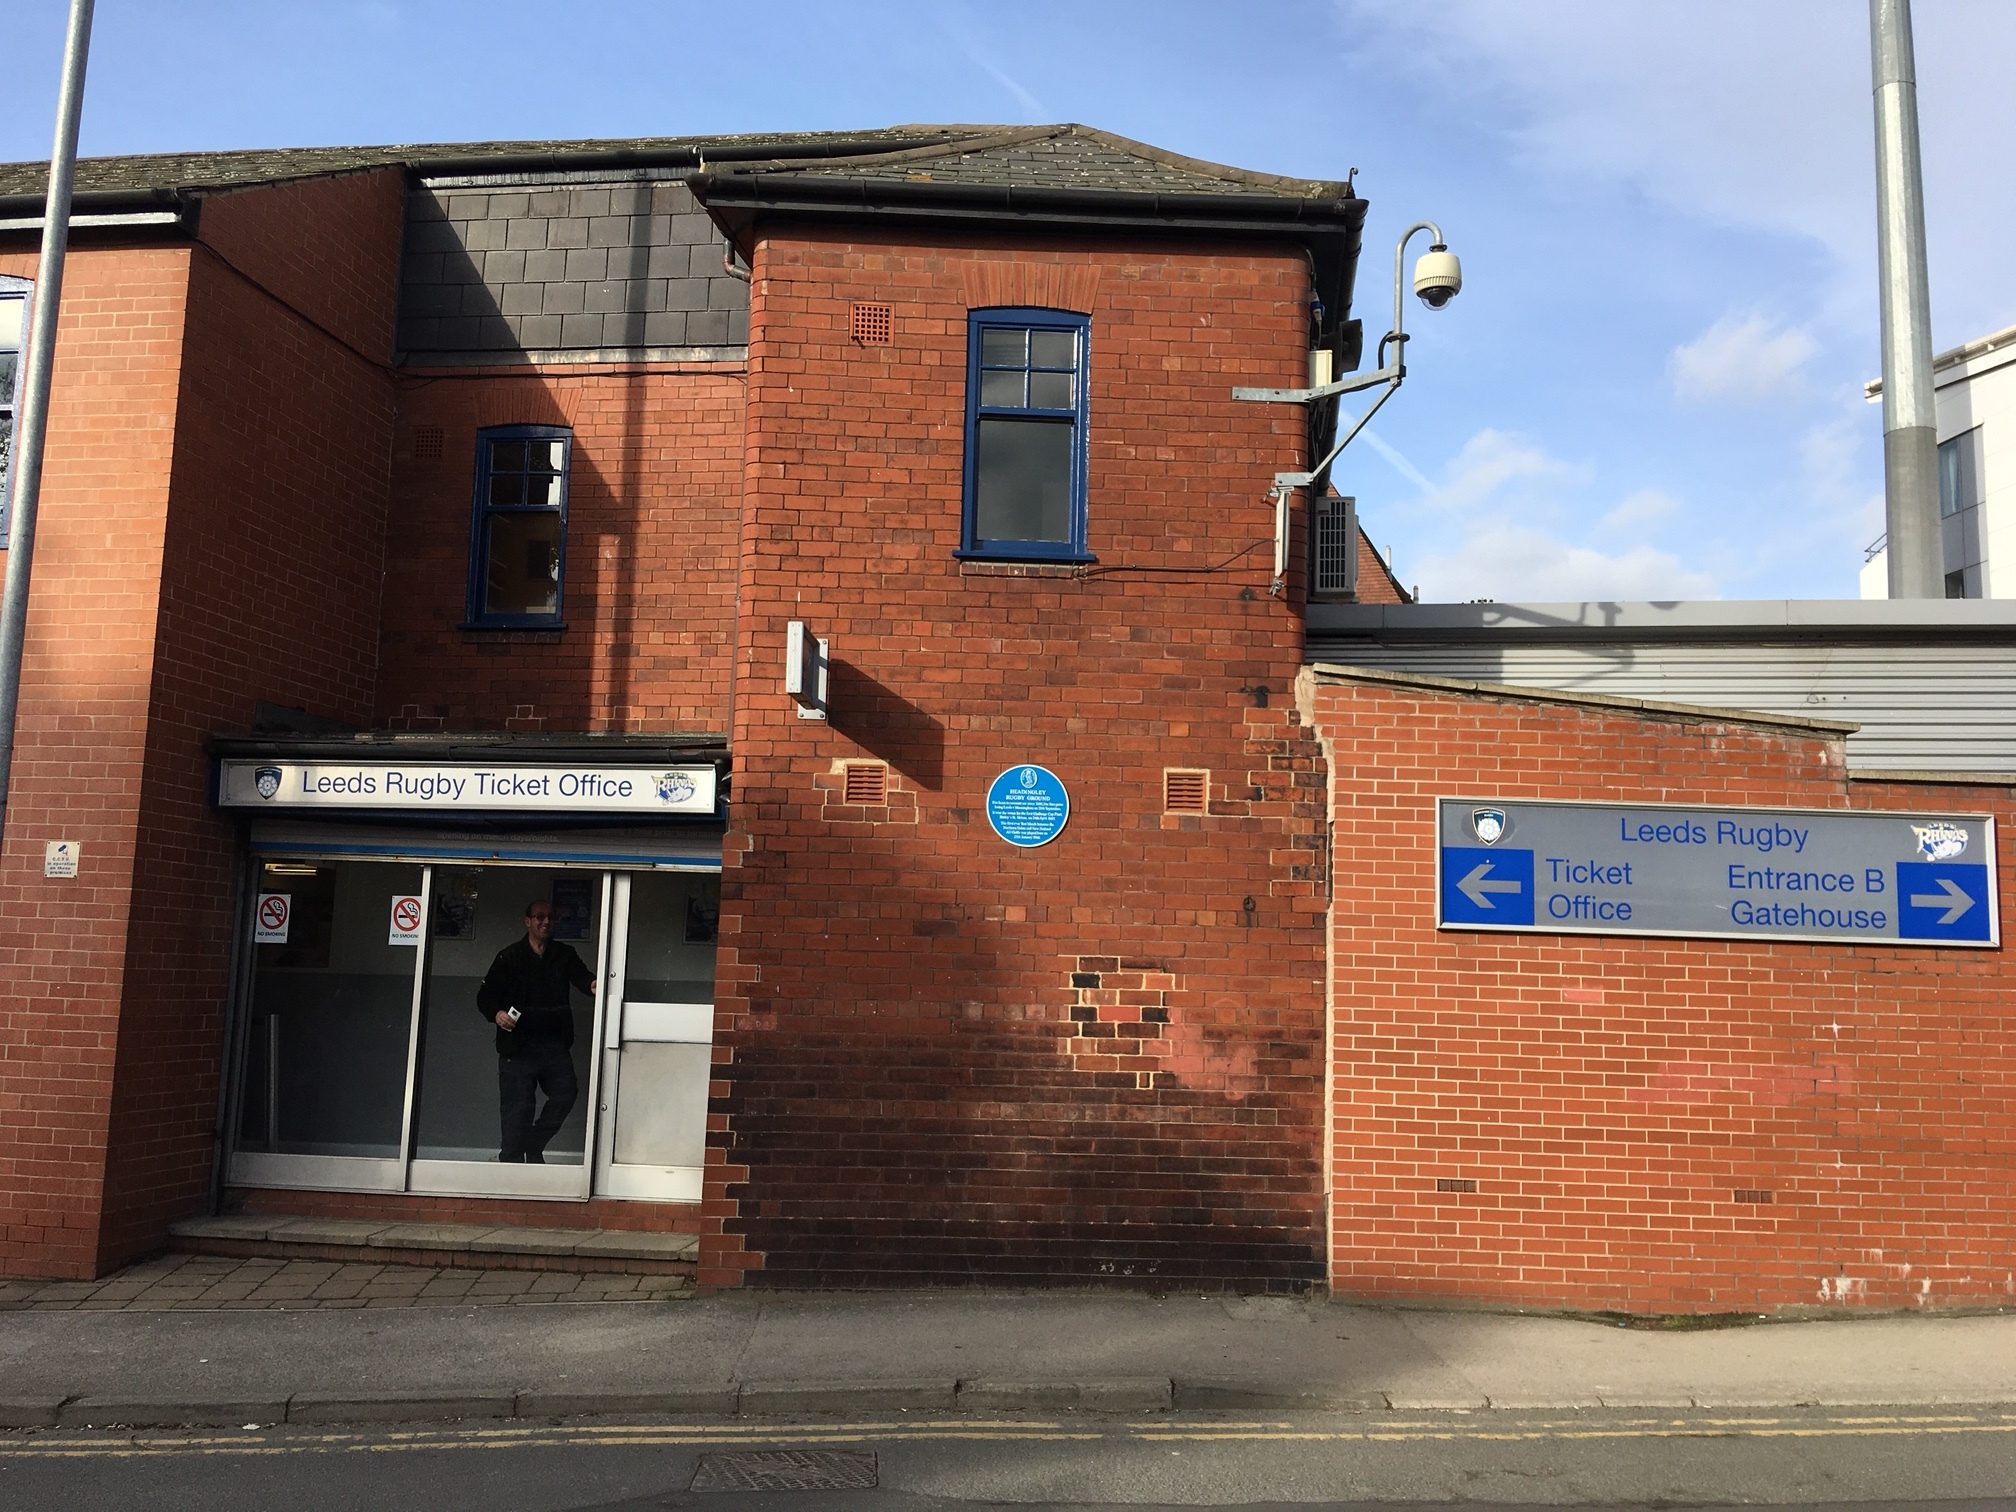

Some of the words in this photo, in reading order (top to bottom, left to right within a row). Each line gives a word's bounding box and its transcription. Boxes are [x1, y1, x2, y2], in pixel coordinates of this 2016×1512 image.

[302, 771, 376, 794] Leeds
[386, 772, 465, 801] Rugby
[475, 773, 549, 796] Ticket
[559, 773, 633, 797] Office
[1621, 818, 1707, 845] Leeds
[1717, 820, 1808, 853] Rugby
[1546, 858, 1632, 885] Ticket
[1728, 864, 1855, 893] Entrance
[1865, 868, 1885, 894] B
[1548, 893, 1632, 921] Office
[1730, 899, 1887, 929] Gatehouse
